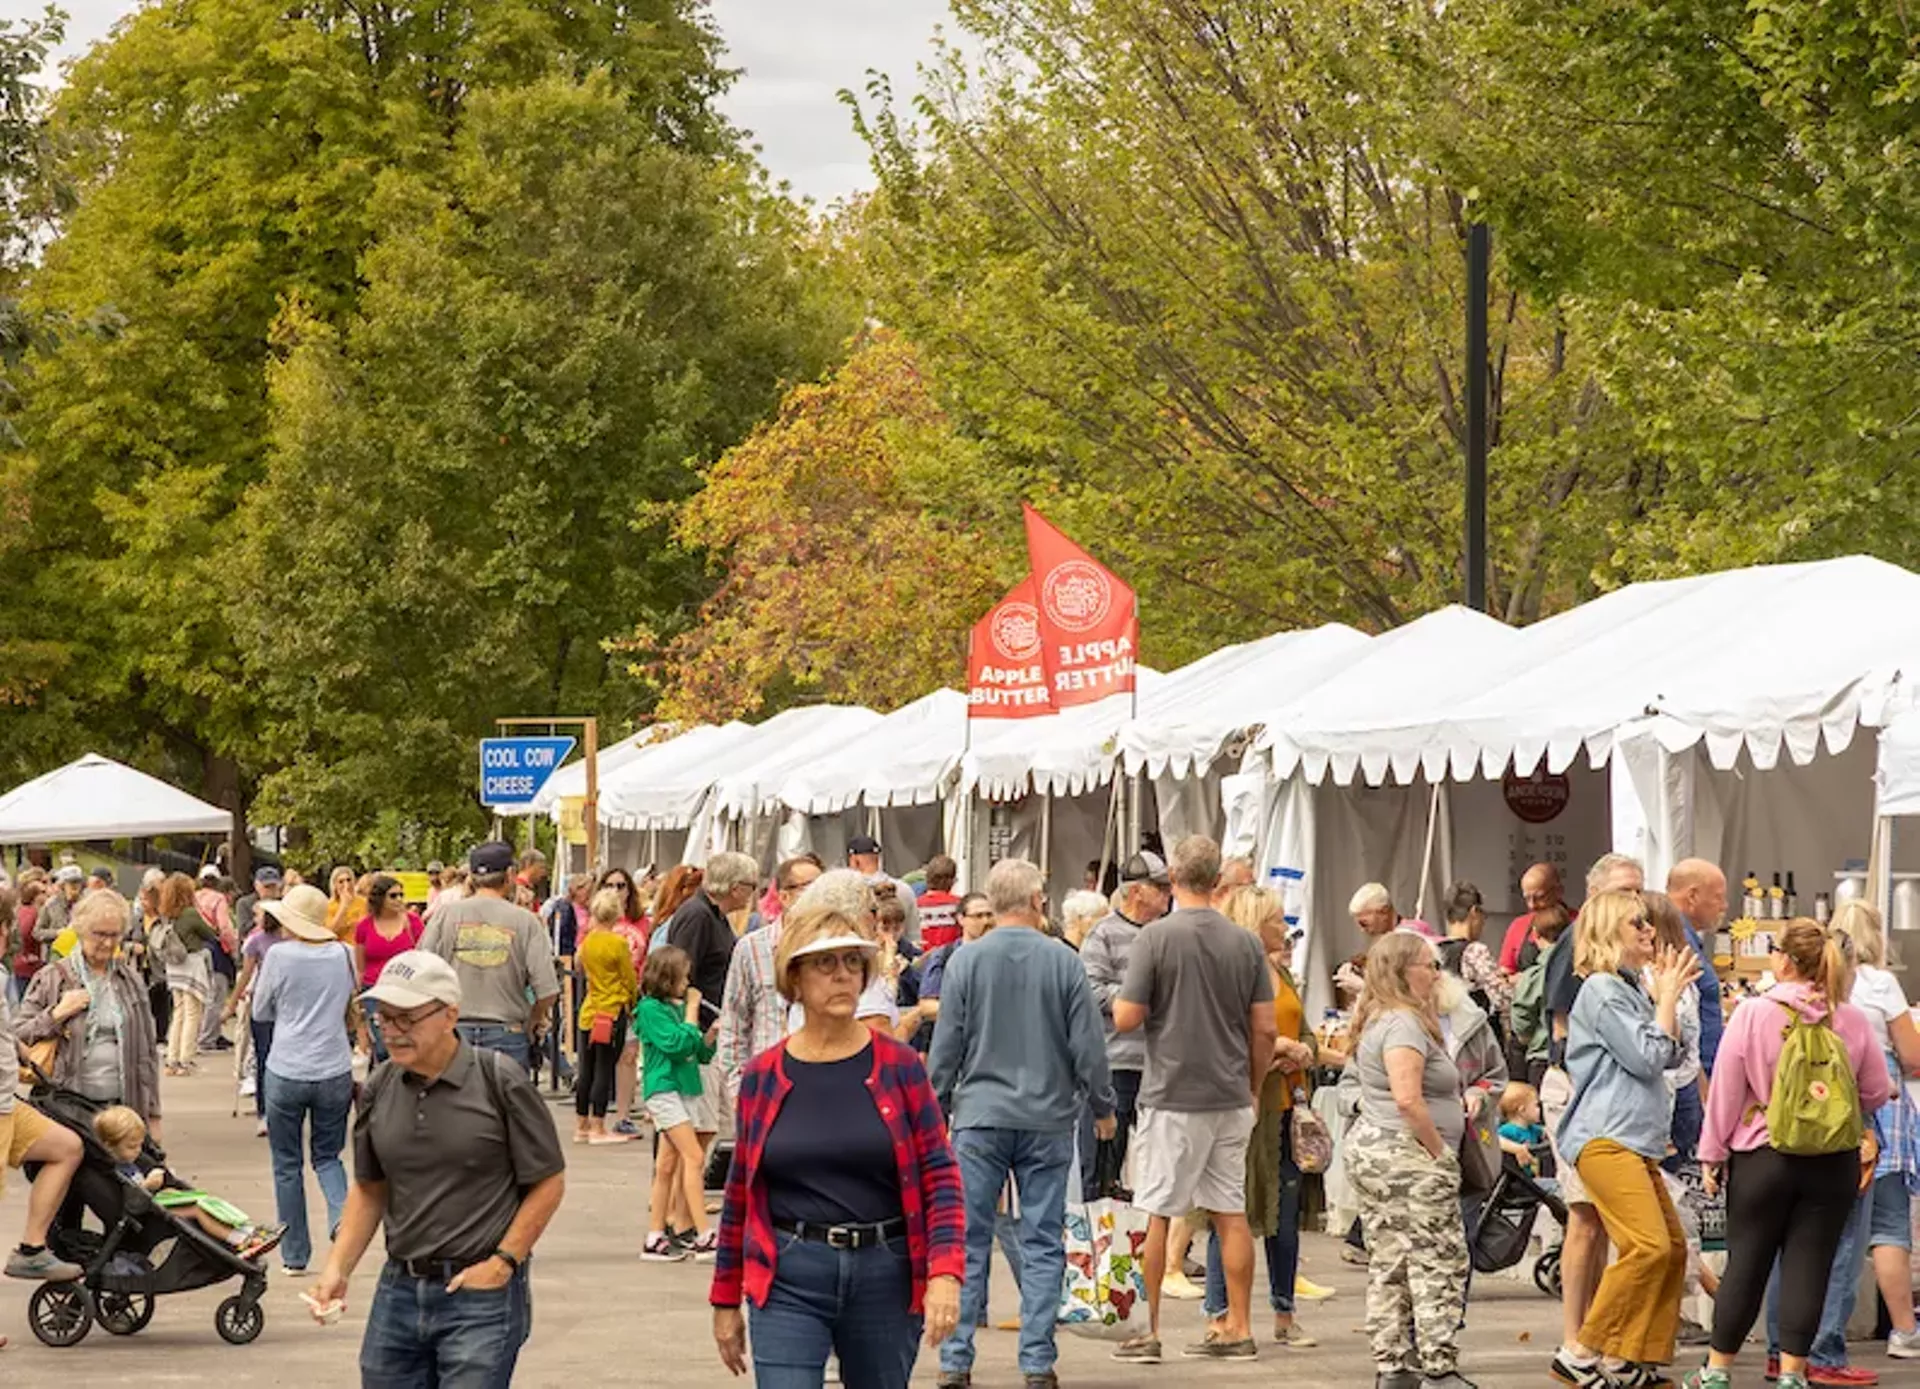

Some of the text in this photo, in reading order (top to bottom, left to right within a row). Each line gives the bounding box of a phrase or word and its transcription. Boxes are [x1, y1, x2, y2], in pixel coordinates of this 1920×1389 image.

[980, 666, 1042, 685] APPLE
[969, 686, 1049, 705] BUTTER
[486, 747, 555, 768] COOL COW
[486, 776, 534, 795] CHEESE
